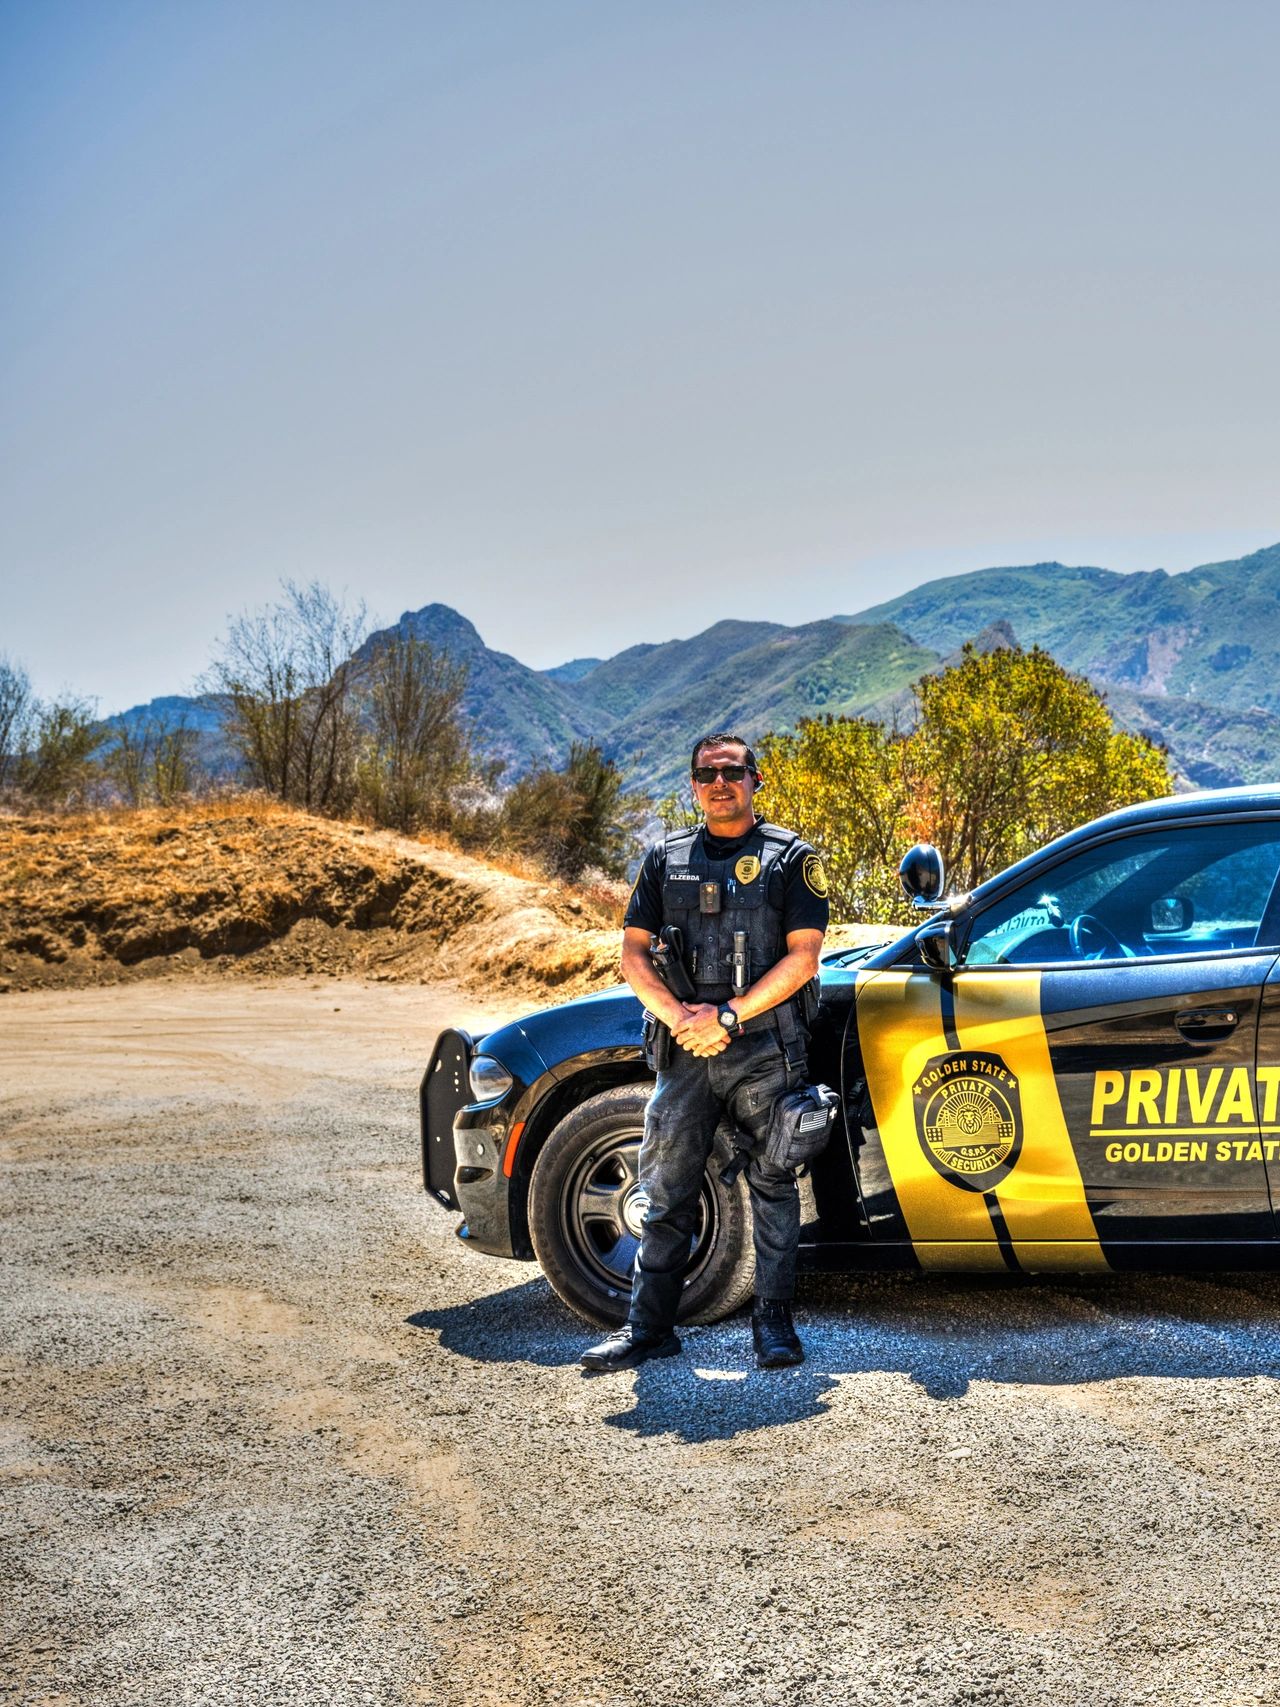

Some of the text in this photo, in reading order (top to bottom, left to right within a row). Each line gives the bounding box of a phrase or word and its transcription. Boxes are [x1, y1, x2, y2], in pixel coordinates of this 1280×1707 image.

[922, 1060, 1007, 1088] GOLDEN STATE
[941, 1081, 992, 1099] PRIVATE
[1105, 1142, 1208, 1162] GOLDEN
[950, 1154, 998, 1171] SECURITY
